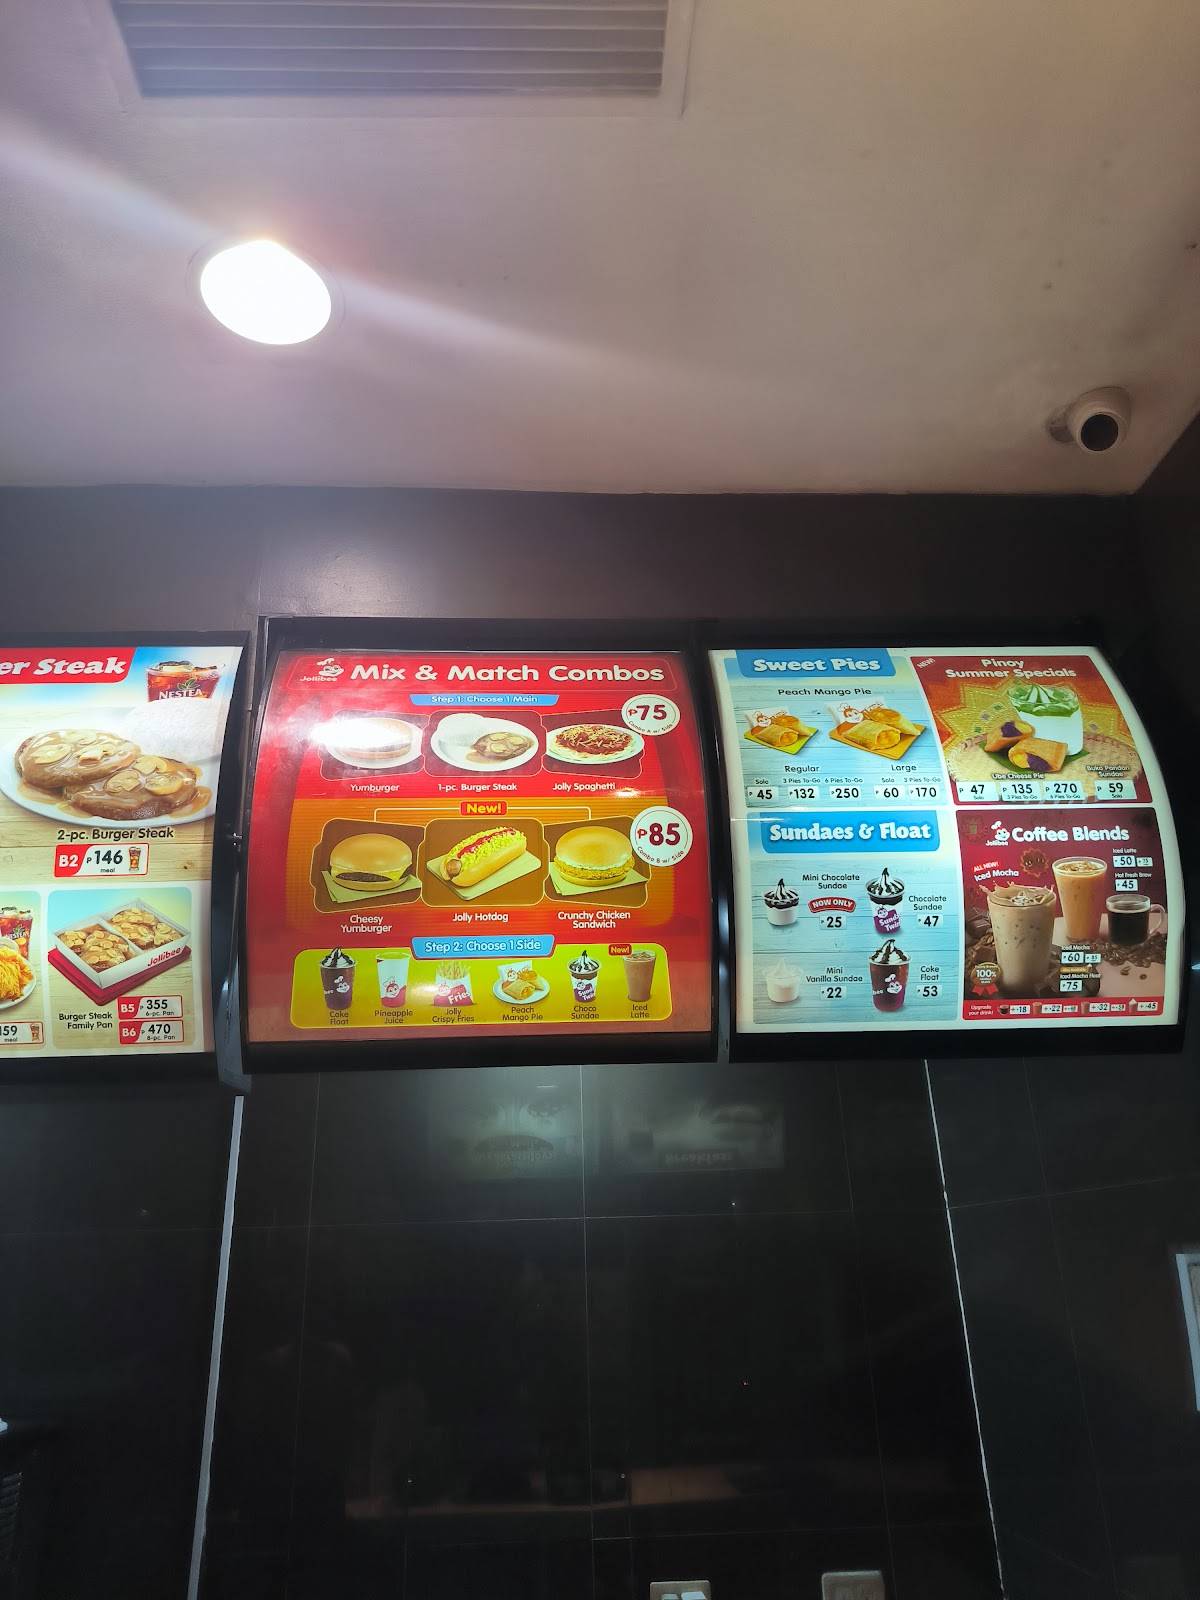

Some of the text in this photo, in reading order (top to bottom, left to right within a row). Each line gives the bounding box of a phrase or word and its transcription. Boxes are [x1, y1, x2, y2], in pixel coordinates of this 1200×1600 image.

[33, 656, 126, 675] Steak
[753, 658, 881, 672] Sweet Pies
[917, 658, 936, 669] NEW!
[981, 659, 1025, 669] Pinoy
[351, 664, 665, 681] Mix & Match Combos
[945, 668, 1077, 679] Summer Specials
[159, 688, 203, 699] NESTEA
[814, 688, 851, 696] Mango
[784, 765, 820, 774] Regular
[891, 764, 917, 772] Large
[350, 784, 400, 793] Yumburger
[461, 783, 491, 792] Burger
[492, 783, 517, 791] Steak
[552, 782, 616, 791] Jolly Spaghetti
[467, 803, 502, 813] New!
[58, 827, 174, 842] 2-pc. Burger Steak
[770, 822, 932, 841] Sundaes & Float
[1012, 825, 1130, 842] Coffee Blends
[637, 846, 654, 861] Combo
[671, 851, 684, 861] Side
[59, 855, 79, 867] B2
[973, 861, 1000, 872] ALL NEW!
[974, 868, 1019, 882] Iced Mocha
[812, 899, 853, 908] NOW ONLY
[908, 895, 947, 903] Chocolate
[913, 903, 943, 911] Sundae
[350, 915, 384, 924] Cheesy
[452, 912, 509, 923] Jolly Hotdog
[558, 911, 631, 921] Crunchy Chicken
[572, 919, 616, 929] Sandwich
[340, 924, 392, 934] Yumburger
[425, 942, 450, 953] Step
[452, 941, 463, 951] 2:
[466, 940, 506, 951] Choose
[516, 940, 541, 950] Side
[611, 946, 630, 954] New!
[147, 948, 181, 967] Jollibee
[826, 966, 843, 974] Mini
[920, 965, 940, 973] Coke
[976, 969, 997, 978] 100%
[806, 975, 832, 983] Vanilla
[920, 972, 939, 981] Float
[448, 991, 471, 1005] Fries
[120, 1004, 135, 1013] B5
[446, 1008, 462, 1016] Jolly
[511, 1006, 534, 1014] Peach
[59, 1012, 113, 1022] Burger Steak
[374, 1009, 413, 1018] Pineapple
[502, 1014, 529, 1022] Mango
[571, 1012, 600, 1020] Sundae
[432, 1015, 455, 1023] Crispy
[67, 1021, 94, 1030] Family
[122, 1028, 136, 1037] B6
